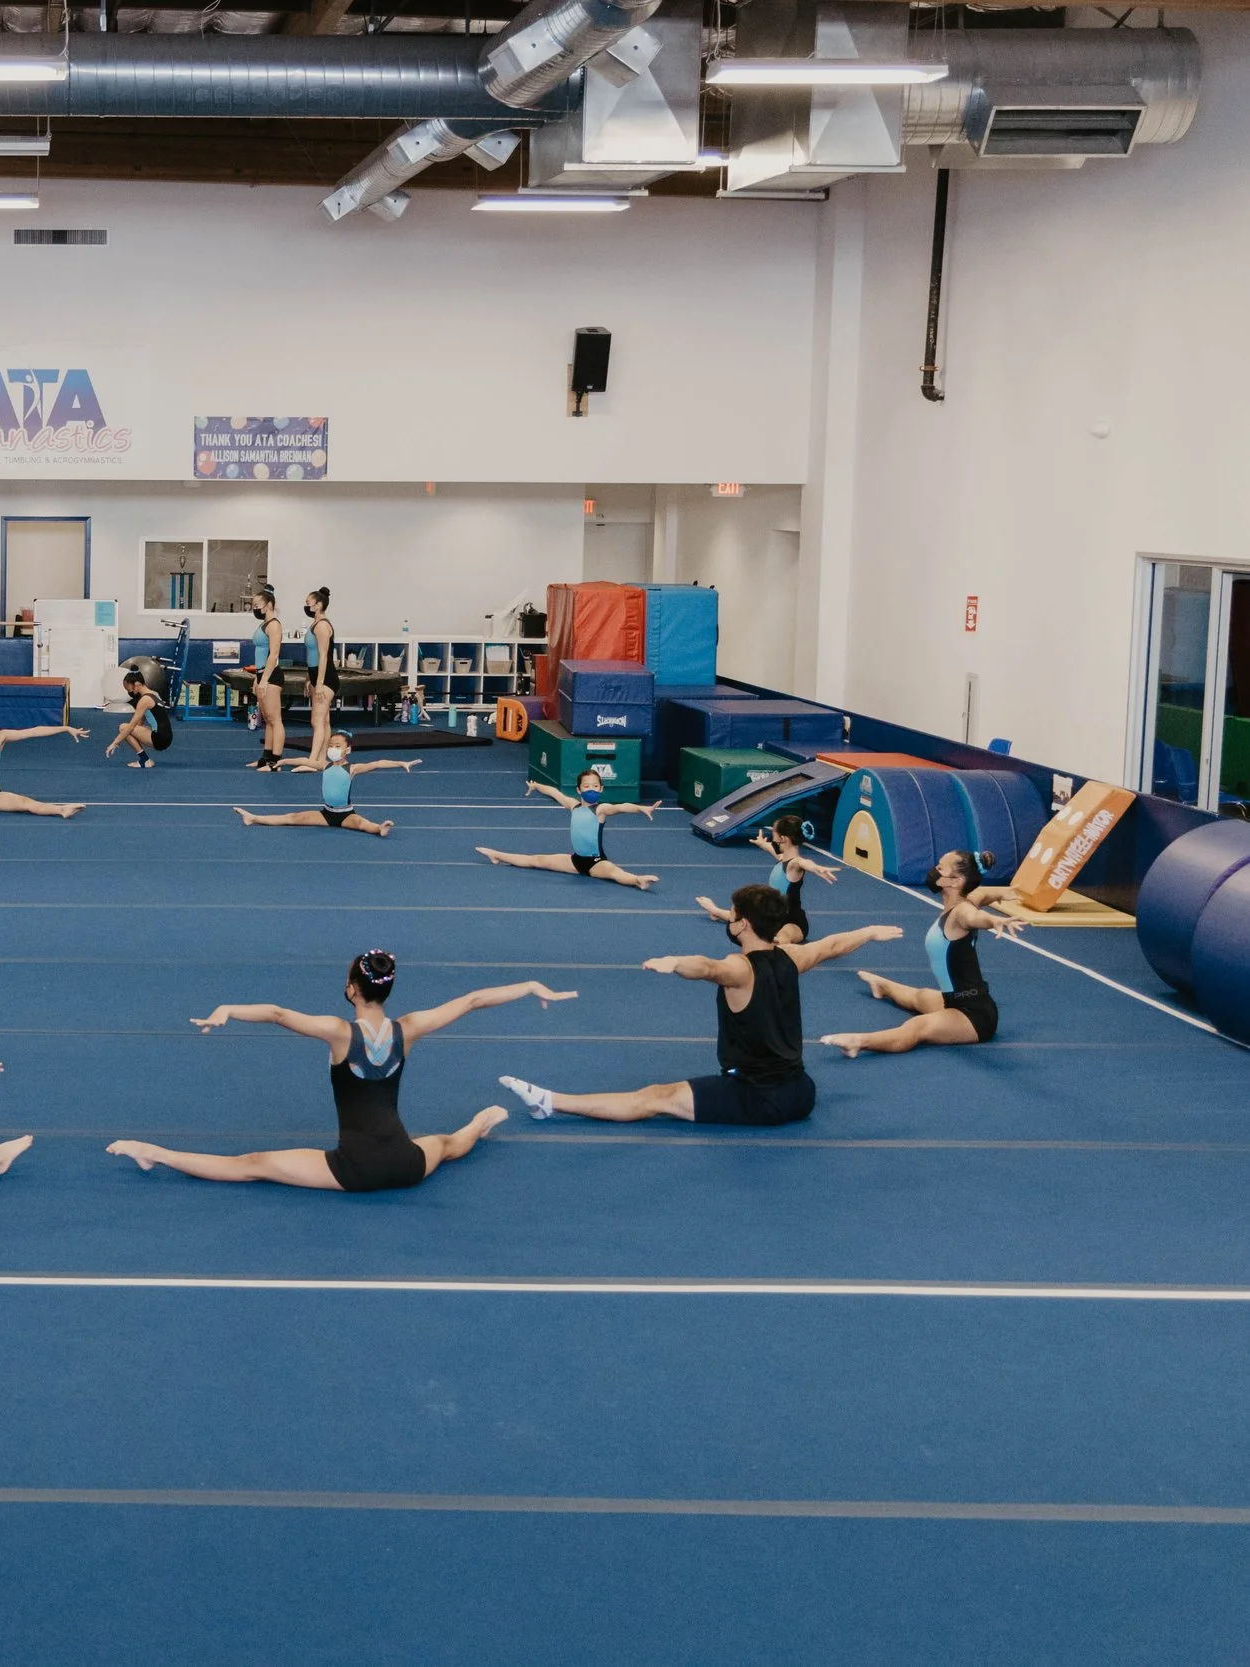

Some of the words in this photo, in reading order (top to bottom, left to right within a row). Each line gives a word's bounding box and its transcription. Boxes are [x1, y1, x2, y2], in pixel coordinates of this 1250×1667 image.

[200, 433, 231, 447] THANK
[234, 433, 253, 447] YOU
[255, 433, 275, 447] ATA
[277, 433, 322, 447] COACHES!
[4, 456, 42, 464] TUMBLING
[52, 456, 123, 464] ACROGYMNASTICS
[211, 449, 240, 462] ALLISON
[240, 449, 278, 462] SAMANTHA
[279, 449, 312, 463] BRENNAN
[718, 482, 740, 495] EXIT
[954, 988, 979, 1000] PRO
